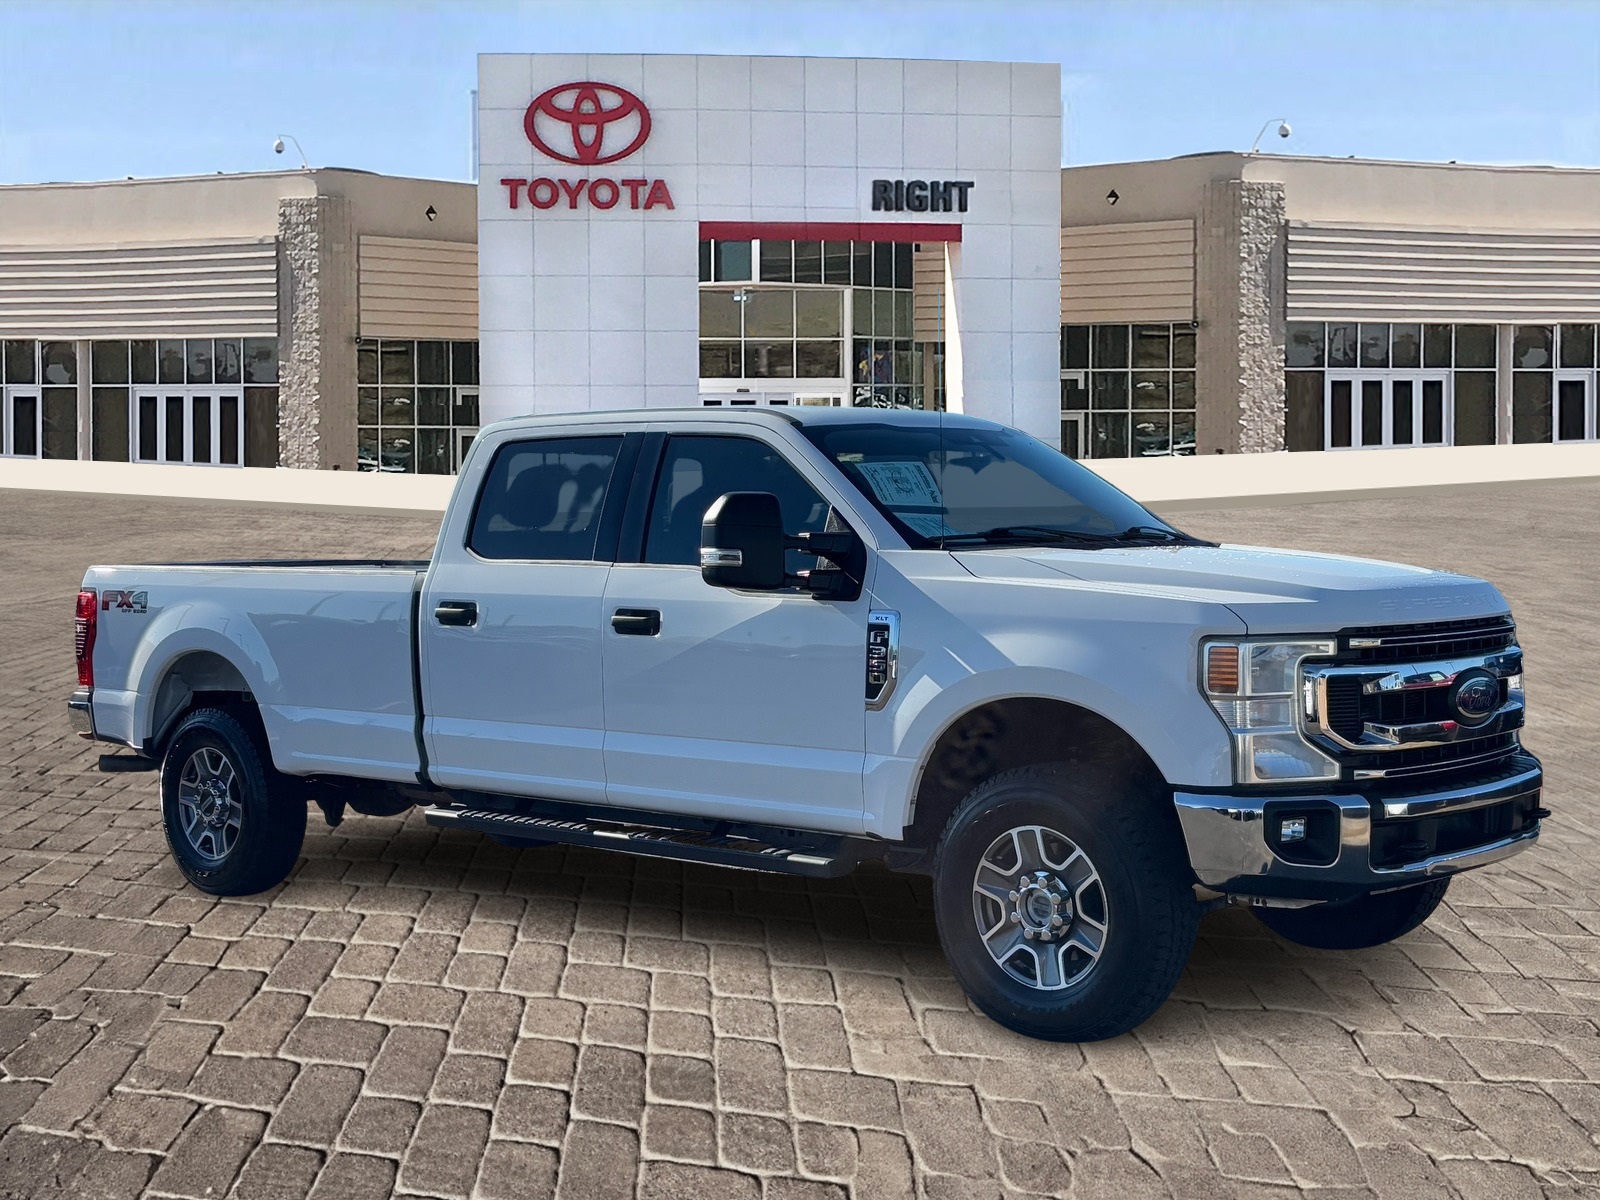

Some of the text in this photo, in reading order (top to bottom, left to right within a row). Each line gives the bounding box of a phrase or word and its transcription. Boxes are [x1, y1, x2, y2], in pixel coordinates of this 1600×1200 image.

[500, 177, 675, 210] TOYOTA
[872, 179, 975, 212] RIGHT
[102, 590, 149, 611] FX4
